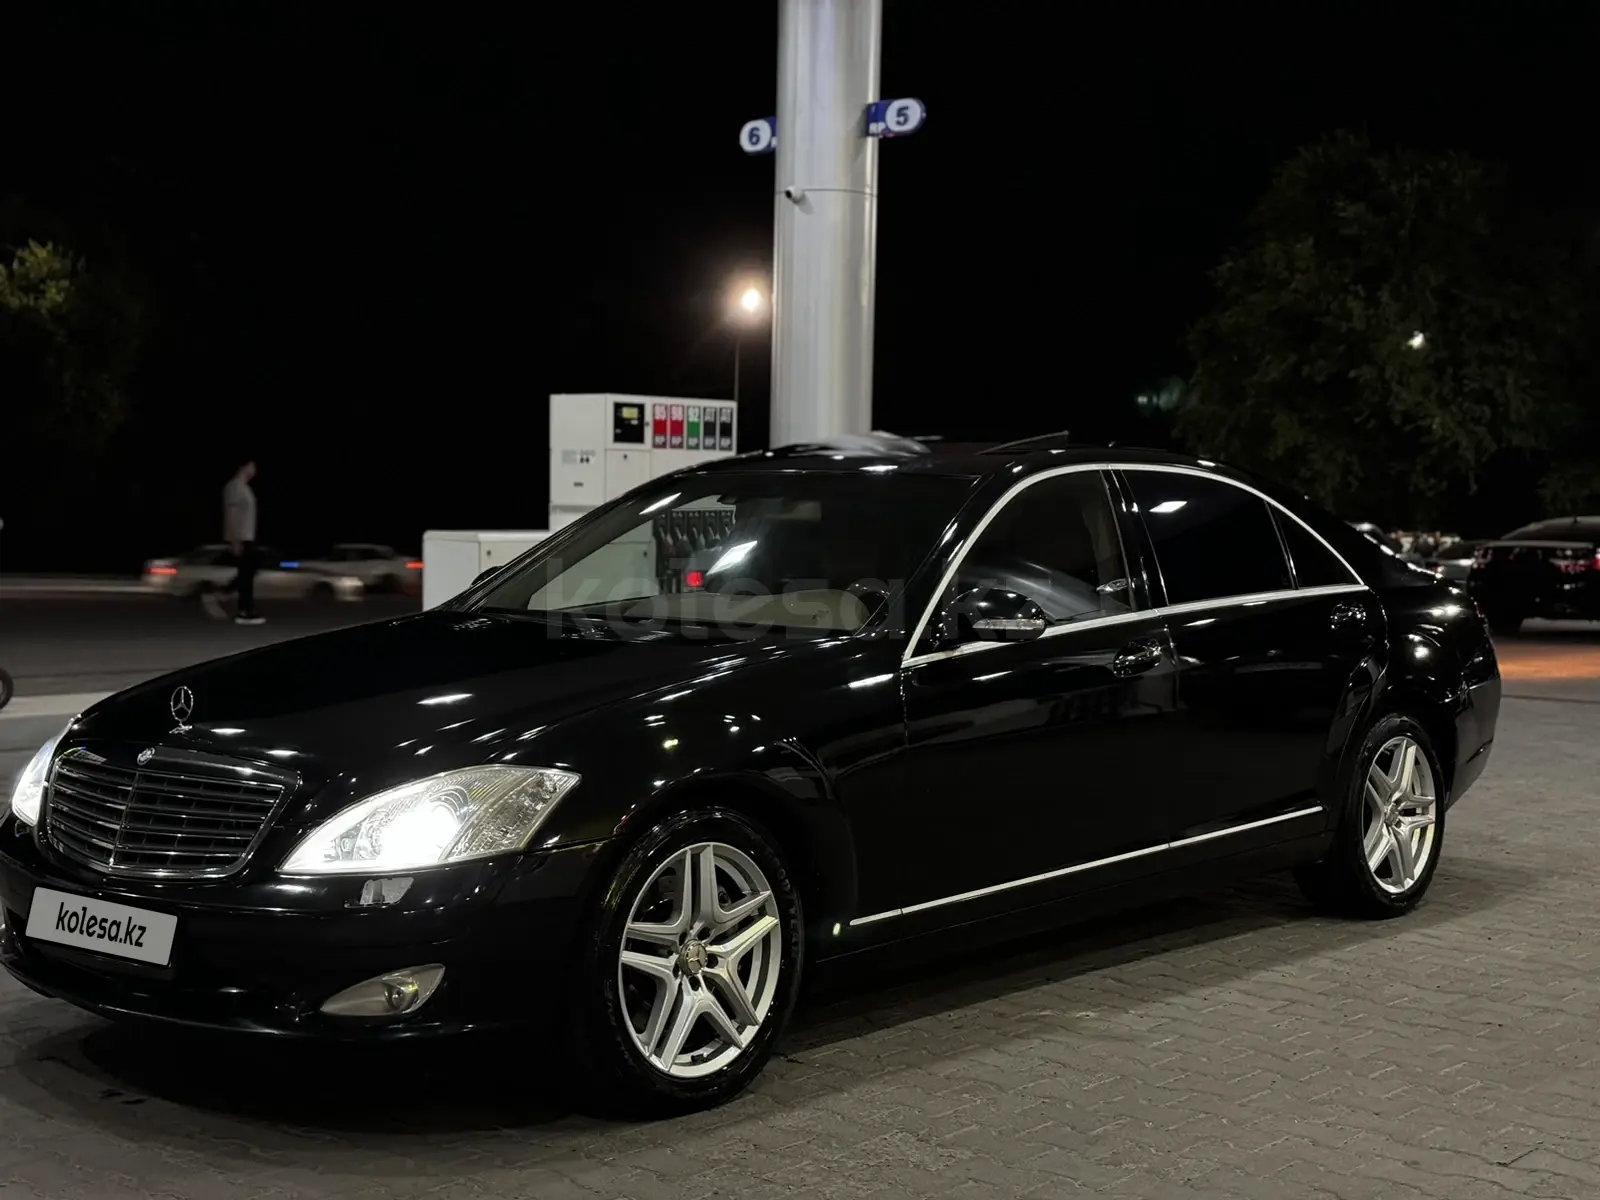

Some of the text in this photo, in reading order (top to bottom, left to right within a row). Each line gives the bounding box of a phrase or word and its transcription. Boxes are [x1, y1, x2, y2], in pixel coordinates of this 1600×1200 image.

[896, 105, 910, 126] 5
[748, 127, 761, 146] 6
[688, 406, 699, 422] 92
